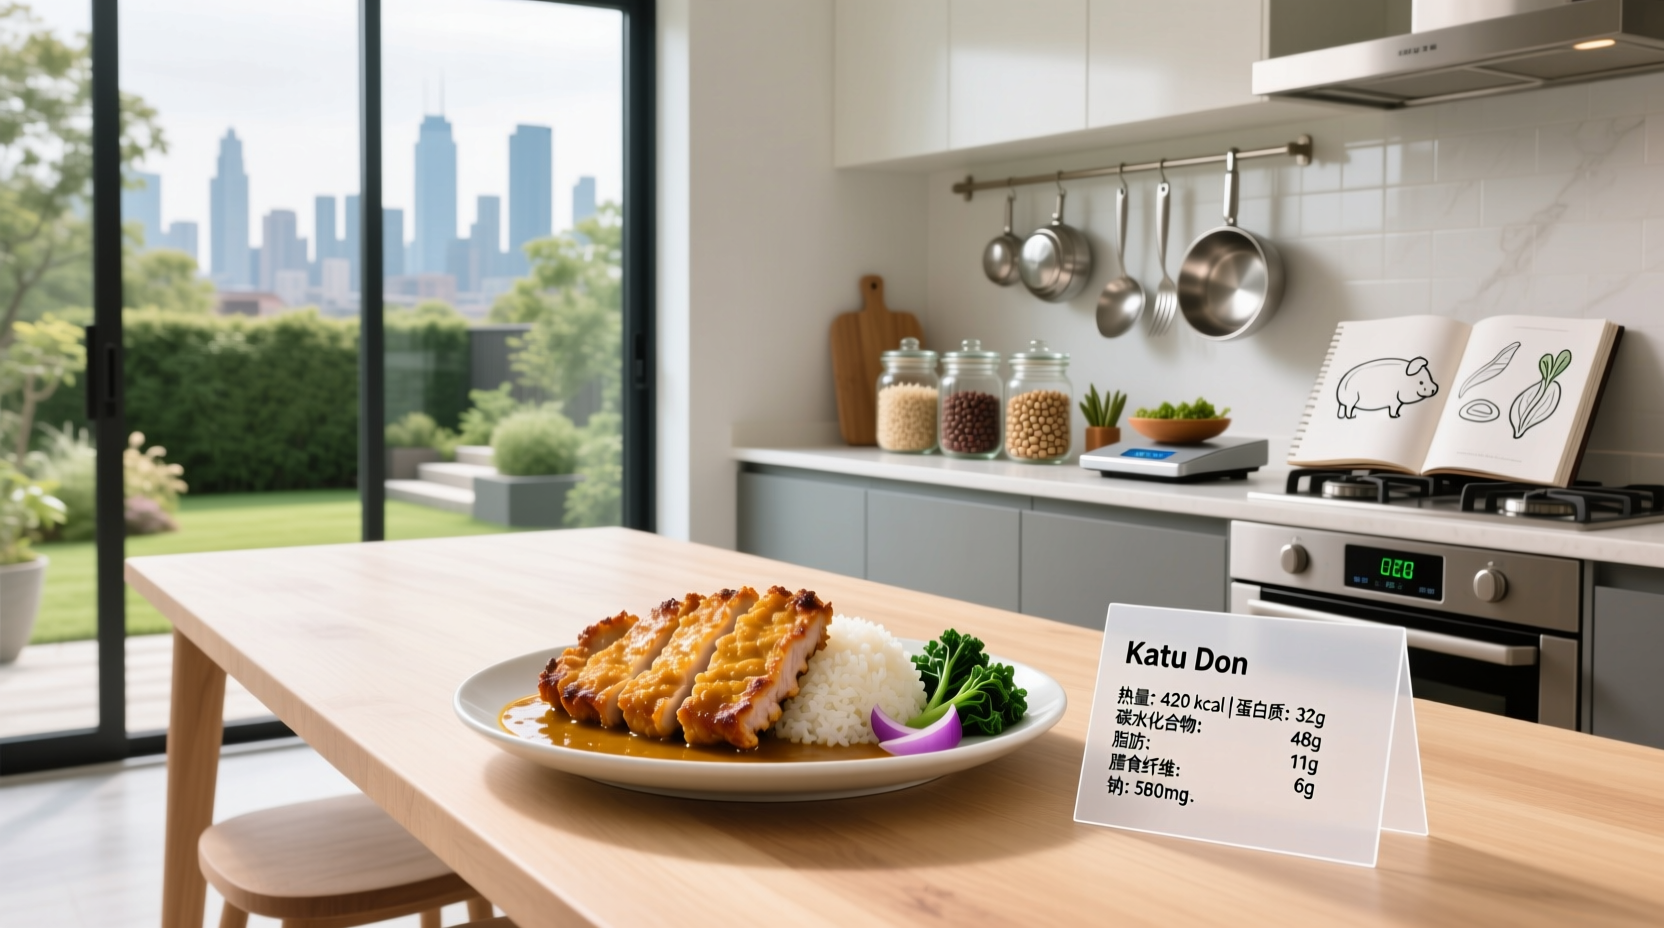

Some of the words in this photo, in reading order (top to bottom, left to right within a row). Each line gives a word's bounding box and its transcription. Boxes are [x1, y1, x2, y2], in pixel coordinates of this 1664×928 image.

[1126, 641, 1186, 669] Katu
[1195, 647, 1247, 675] Don
[1160, 692, 1190, 708] 420
[1194, 694, 1225, 712] kcal
[1296, 707, 1325, 728] 32g
[1291, 732, 1321, 752] 48g
[1291, 755, 1318, 775] 11g
[1134, 780, 1194, 806] 580mg.
[1294, 778, 1314, 799] 6g
